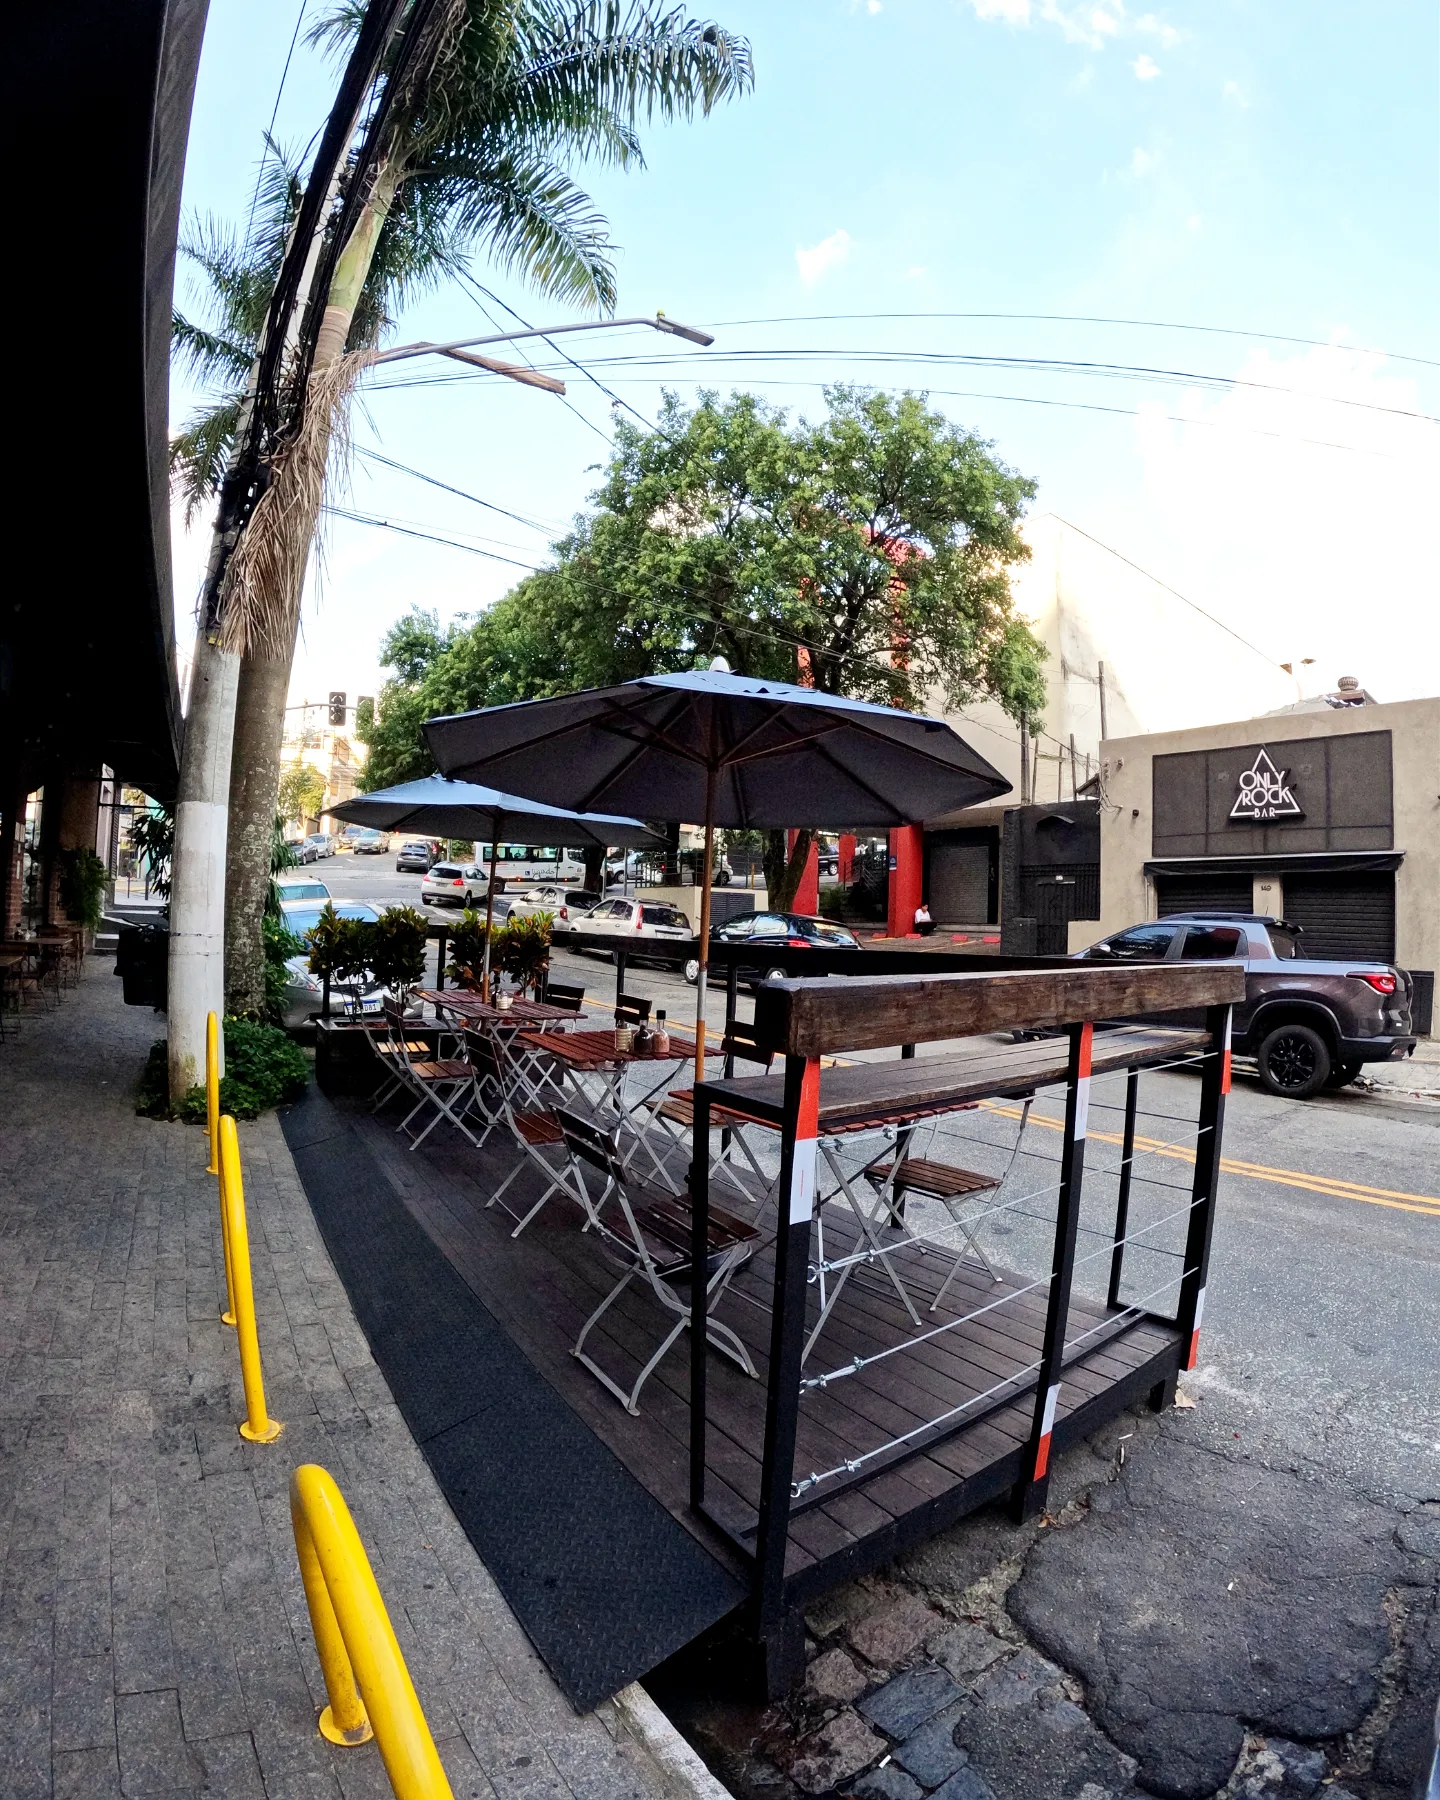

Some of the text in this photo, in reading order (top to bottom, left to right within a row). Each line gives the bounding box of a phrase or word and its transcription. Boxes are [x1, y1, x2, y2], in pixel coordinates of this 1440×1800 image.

[1239, 770, 1285, 790] ONLY
[1242, 786, 1290, 806] ROCK
[1254, 807, 1275, 818] BAR
